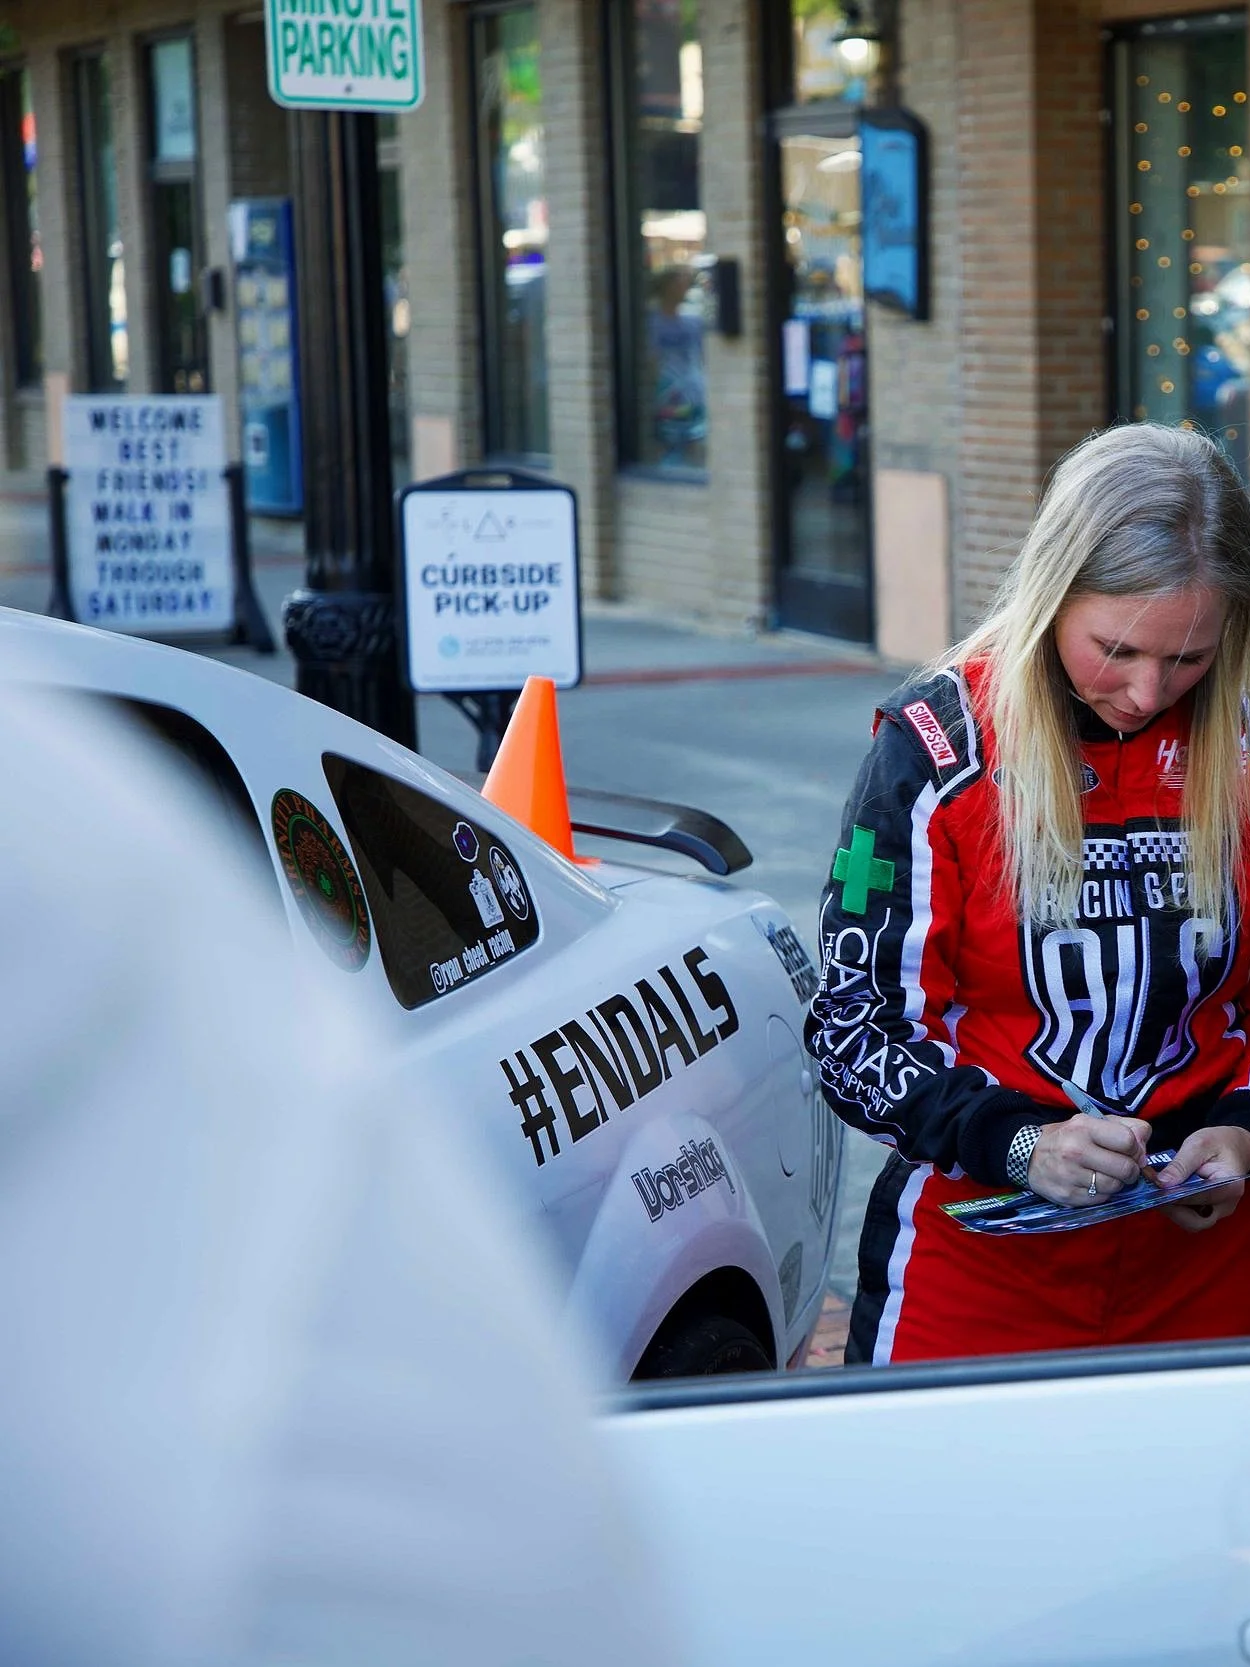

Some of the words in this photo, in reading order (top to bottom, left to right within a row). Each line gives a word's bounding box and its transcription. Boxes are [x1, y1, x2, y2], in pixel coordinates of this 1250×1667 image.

[281, 20, 408, 80] PARKING
[89, 406, 202, 433] WELCOME
[118, 438, 179, 462] BEST
[97, 468, 208, 492] FRIENDS!
[92, 502, 153, 523] WALK
[169, 502, 193, 521] IN
[96, 530, 191, 554] MONDAY
[97, 559, 206, 583] THROUGH
[421, 563, 563, 589] CURBSIDE
[88, 590, 213, 618] SATURDAY
[434, 591, 550, 616] PICK-UP
[909, 705, 953, 761] SIMPSON
[1042, 917, 1224, 1100] ALS
[499, 945, 739, 1167] #ENDALS
